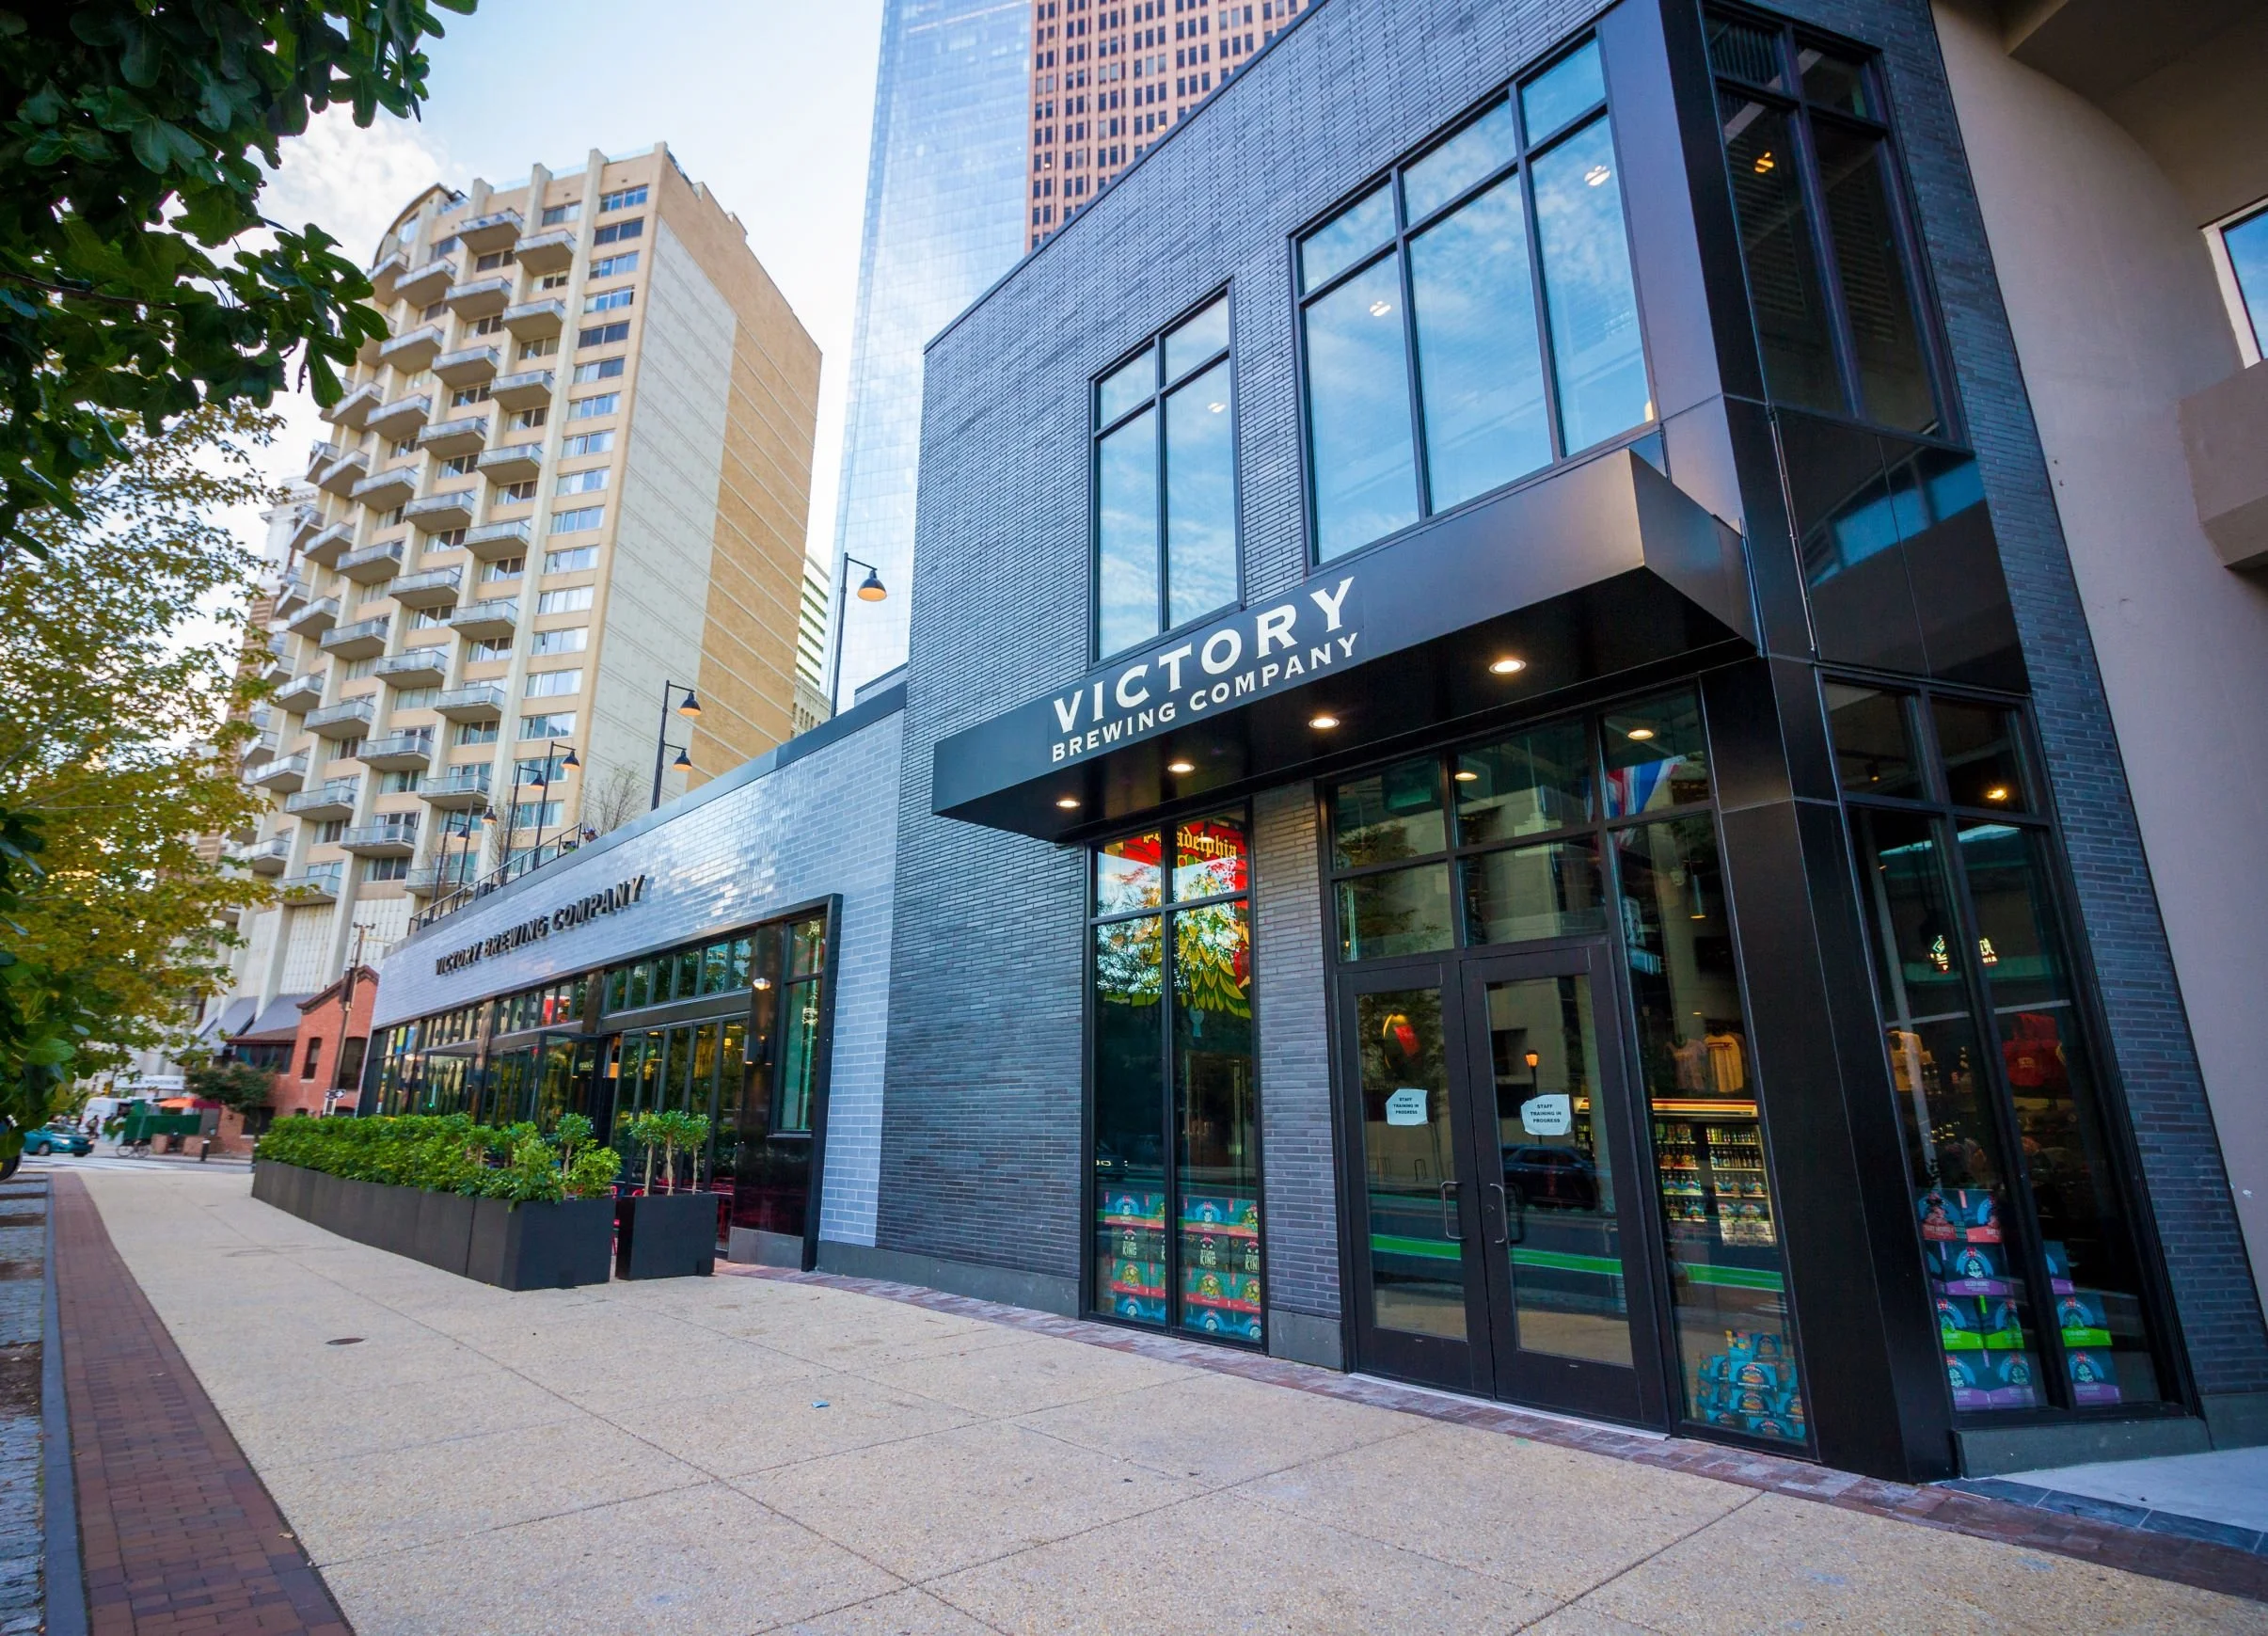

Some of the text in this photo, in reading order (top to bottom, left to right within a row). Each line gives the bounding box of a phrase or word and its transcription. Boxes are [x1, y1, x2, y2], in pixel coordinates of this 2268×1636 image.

[1053, 576, 1356, 734] VICTORY
[1052, 632, 1358, 763] BREWING COMPANY
[436, 874, 647, 976] VICTORY BREWING COMPANY
[1122, 1246, 1137, 1257] KING
[1199, 1254, 1216, 1265] KING
[1245, 1260, 1260, 1271] KIN
